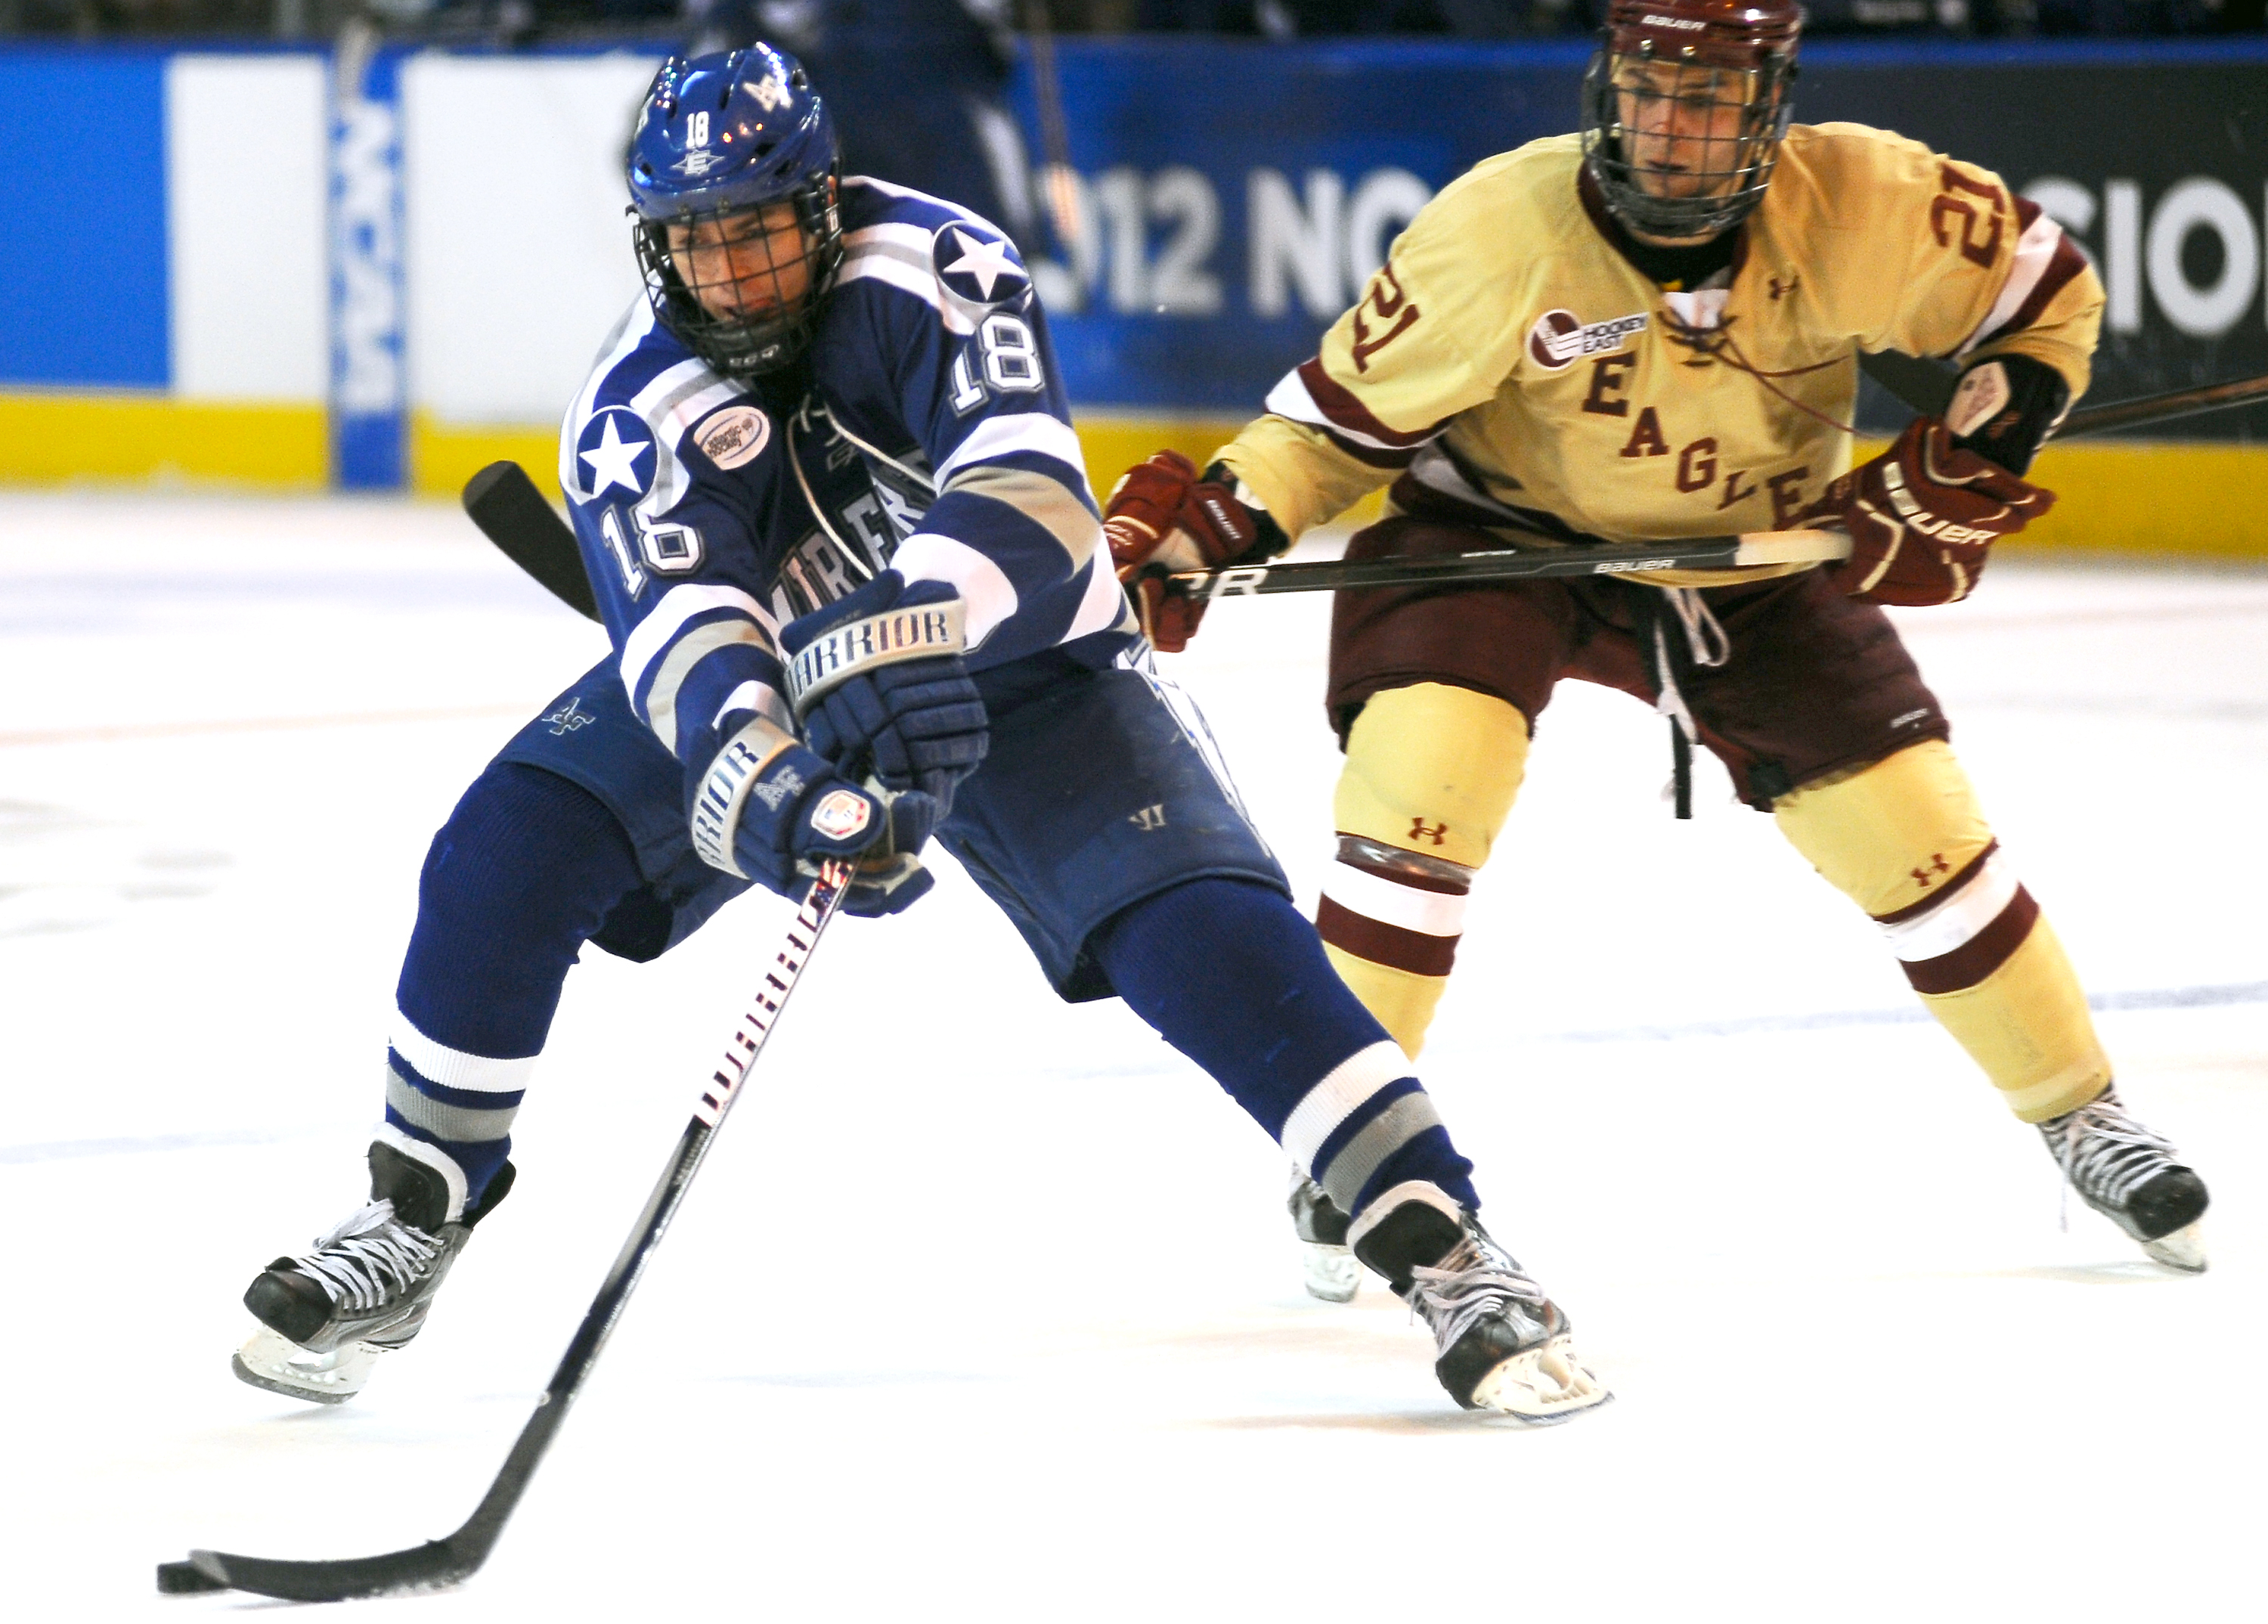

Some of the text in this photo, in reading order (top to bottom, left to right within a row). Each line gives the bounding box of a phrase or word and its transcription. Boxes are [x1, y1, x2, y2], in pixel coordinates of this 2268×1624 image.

[686, 111, 709, 149] 18
[1931, 161, 2004, 269] 21
[1351, 262, 1421, 373] 21
[1581, 315, 1647, 340] HOCKEY
[1581, 334, 1623, 355] EAST
[950, 311, 1046, 417] 18
[1593, 559, 1677, 575] BAUER
[788, 611, 950, 699] ARRIOR
